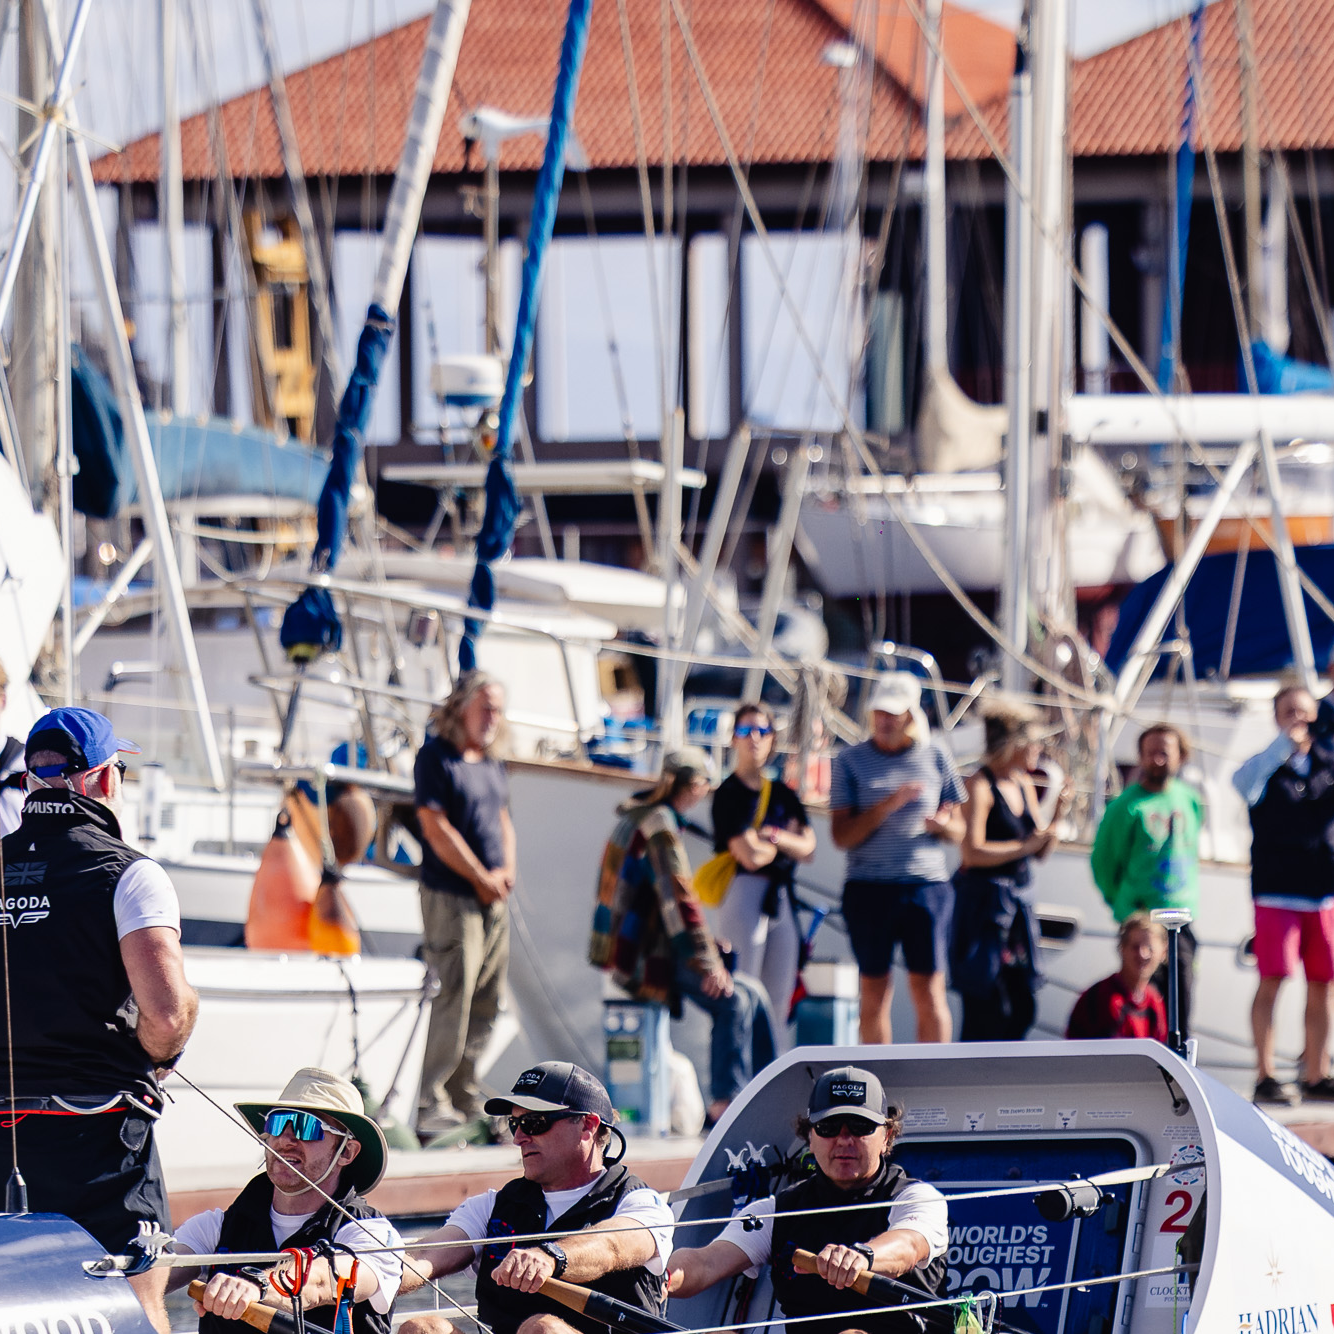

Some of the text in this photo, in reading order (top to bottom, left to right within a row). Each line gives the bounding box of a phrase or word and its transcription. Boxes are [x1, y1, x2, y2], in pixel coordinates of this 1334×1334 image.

[22, 801, 75, 813] MUSTO
[948, 1225, 1048, 1245] WORLD'S
[946, 1246, 1055, 1265] OUGHEST
